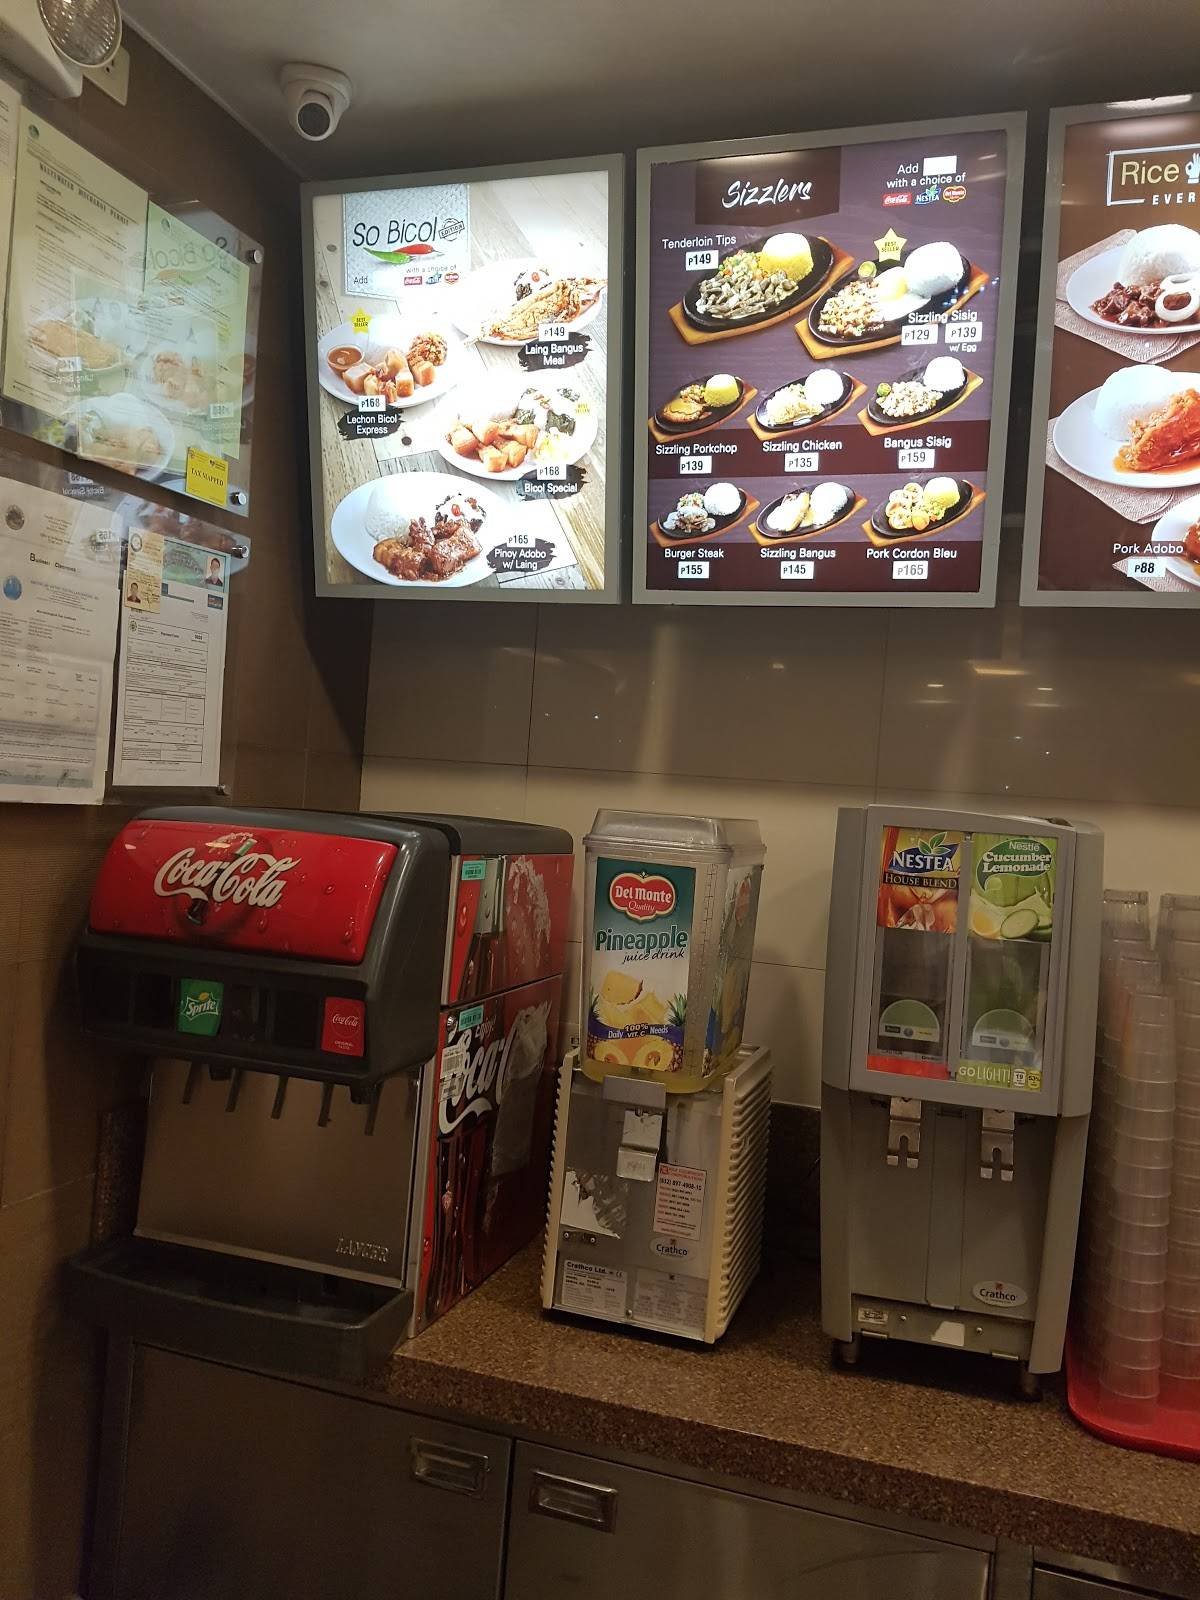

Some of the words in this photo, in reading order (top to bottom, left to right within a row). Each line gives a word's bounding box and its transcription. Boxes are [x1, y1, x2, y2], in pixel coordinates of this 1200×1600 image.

[897, 162, 919, 175] Add
[1121, 160, 1180, 186] Rice
[886, 177, 908, 189] with
[920, 173, 953, 187] choice
[955, 172, 967, 183] of
[721, 177, 813, 209] Sizzlers
[352, 222, 380, 247] So
[387, 216, 438, 244] Bicol
[662, 236, 713, 249] Tenderloin
[715, 235, 737, 247] Tips
[353, 275, 368, 285] Add
[908, 311, 948, 325] Sizzling
[951, 310, 978, 323] Sisig
[525, 344, 549, 356] Laing
[550, 342, 584, 355] Bangus
[961, 343, 977, 354] Egg
[543, 355, 566, 366] Meal
[346, 414, 377, 425] Lechon
[378, 414, 398, 424] Bicol
[356, 424, 388, 436] Express
[655, 444, 691, 456] Sizzling
[692, 443, 738, 456] Porkchop
[762, 440, 801, 454] Sizzling
[802, 439, 842, 451] Chicken
[884, 437, 924, 450] Bangus
[926, 436, 952, 449] Sisig
[524, 482, 546, 493] Bicol
[547, 482, 578, 494] Special
[494, 548, 517, 560] Pinoy
[517, 549, 546, 559] Adobo
[664, 548, 696, 560] Burger
[698, 547, 724, 558] Steak
[760, 548, 798, 560] Sizzling
[799, 547, 836, 559] Bangus
[866, 548, 892, 558] Pork
[893, 548, 931, 559] Cordon
[932, 548, 957, 558] Bleu
[1113, 543, 1141, 555] Pork
[1144, 542, 1184, 554] Adobo
[515, 559, 538, 571] Laing
[892, 850, 954, 872] NESTEA
[981, 852, 1052, 864] Cucumber
[981, 862, 1051, 874] Lemonade
[153, 847, 302, 908] Coca-Cola
[884, 872, 920, 887] HOUSE
[923, 876, 957, 889] BLEND
[615, 885, 633, 900] Del
[635, 887, 672, 904] Monte
[628, 900, 656, 913] Quality
[594, 924, 689, 955] Pineapple
[621, 951, 651, 965] juice
[651, 947, 686, 960] drink
[185, 998, 217, 1017] Sprite
[608, 1030, 624, 1039] Daily
[650, 1025, 669, 1035] Needs
[624, 1023, 649, 1032] 100%
[959, 1066, 976, 1077] GO
[656, 1243, 688, 1256] Crathco
[566, 1261, 593, 1272] Crathco
[979, 1288, 1016, 1302] Crathco
